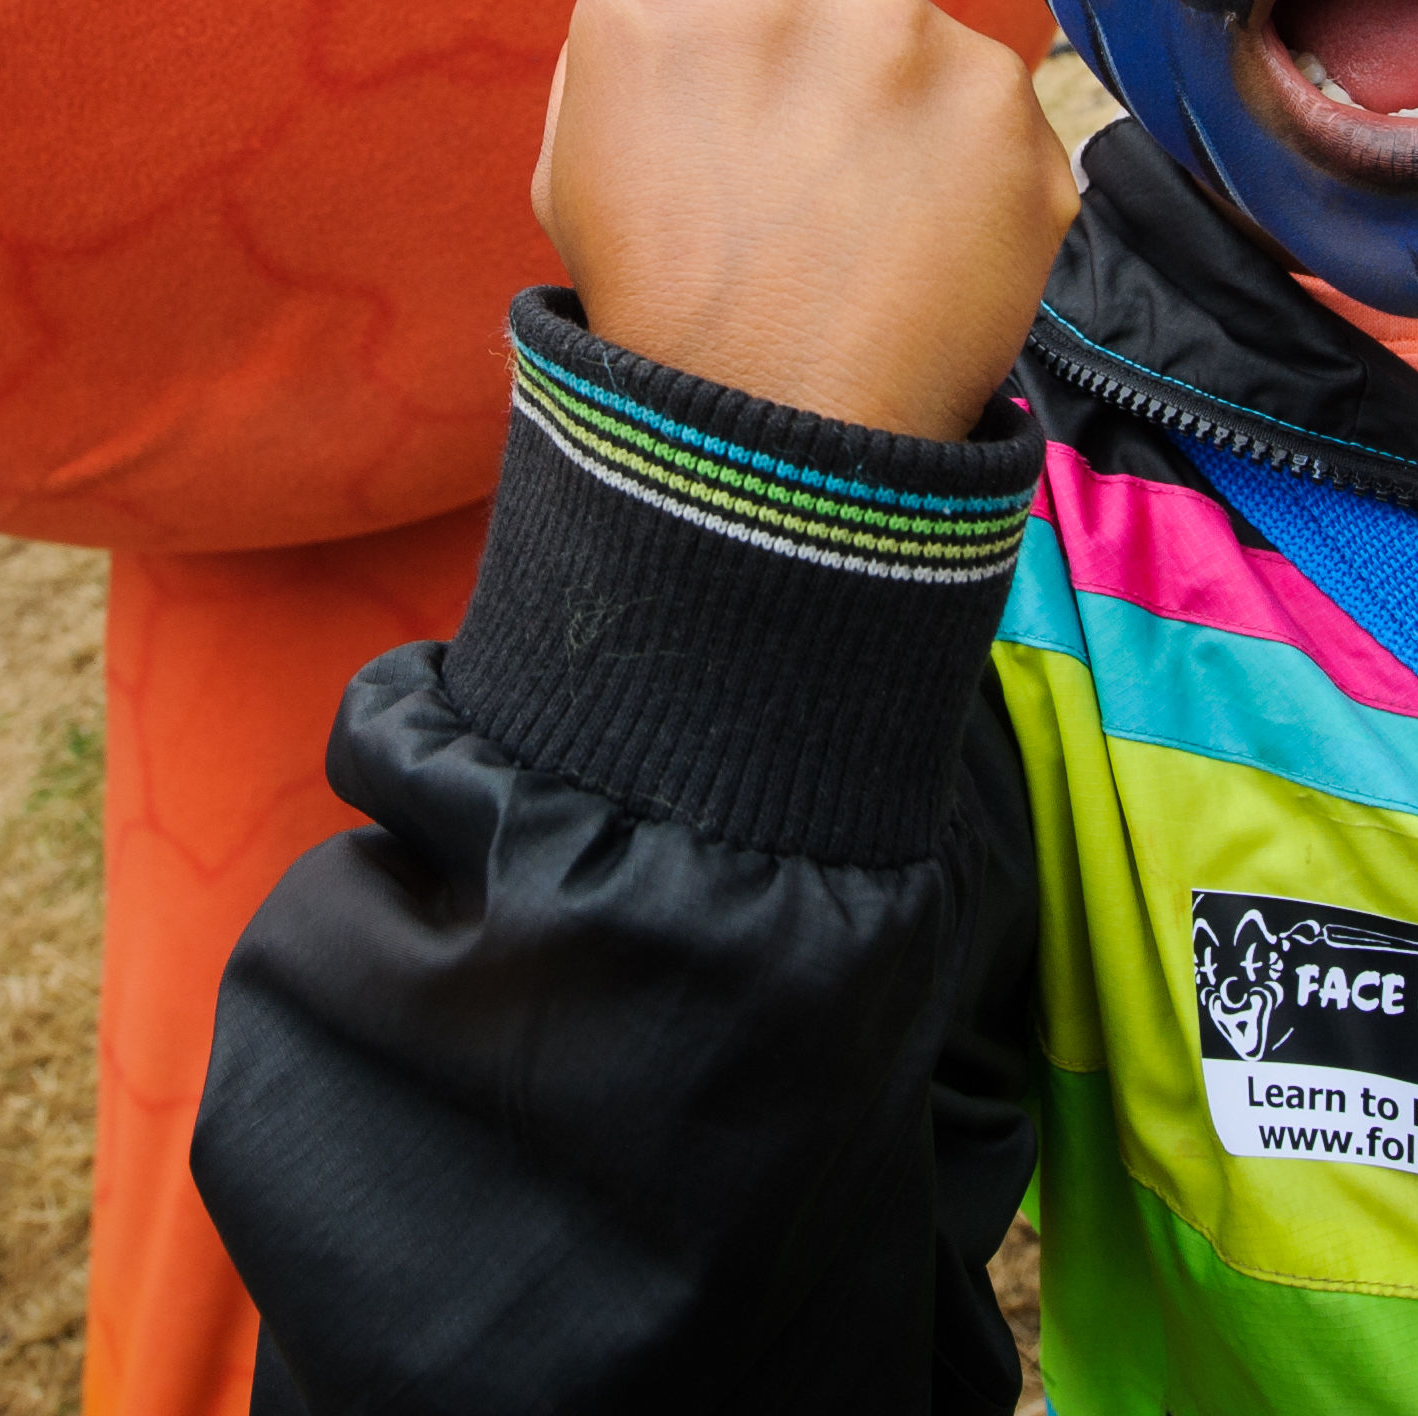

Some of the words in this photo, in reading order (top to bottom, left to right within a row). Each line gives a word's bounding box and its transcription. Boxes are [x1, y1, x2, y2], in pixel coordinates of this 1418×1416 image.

[1295, 963, 1405, 1015] FACE
[1247, 1075, 1347, 1113] Learn
[1361, 1087, 1399, 1121] to
